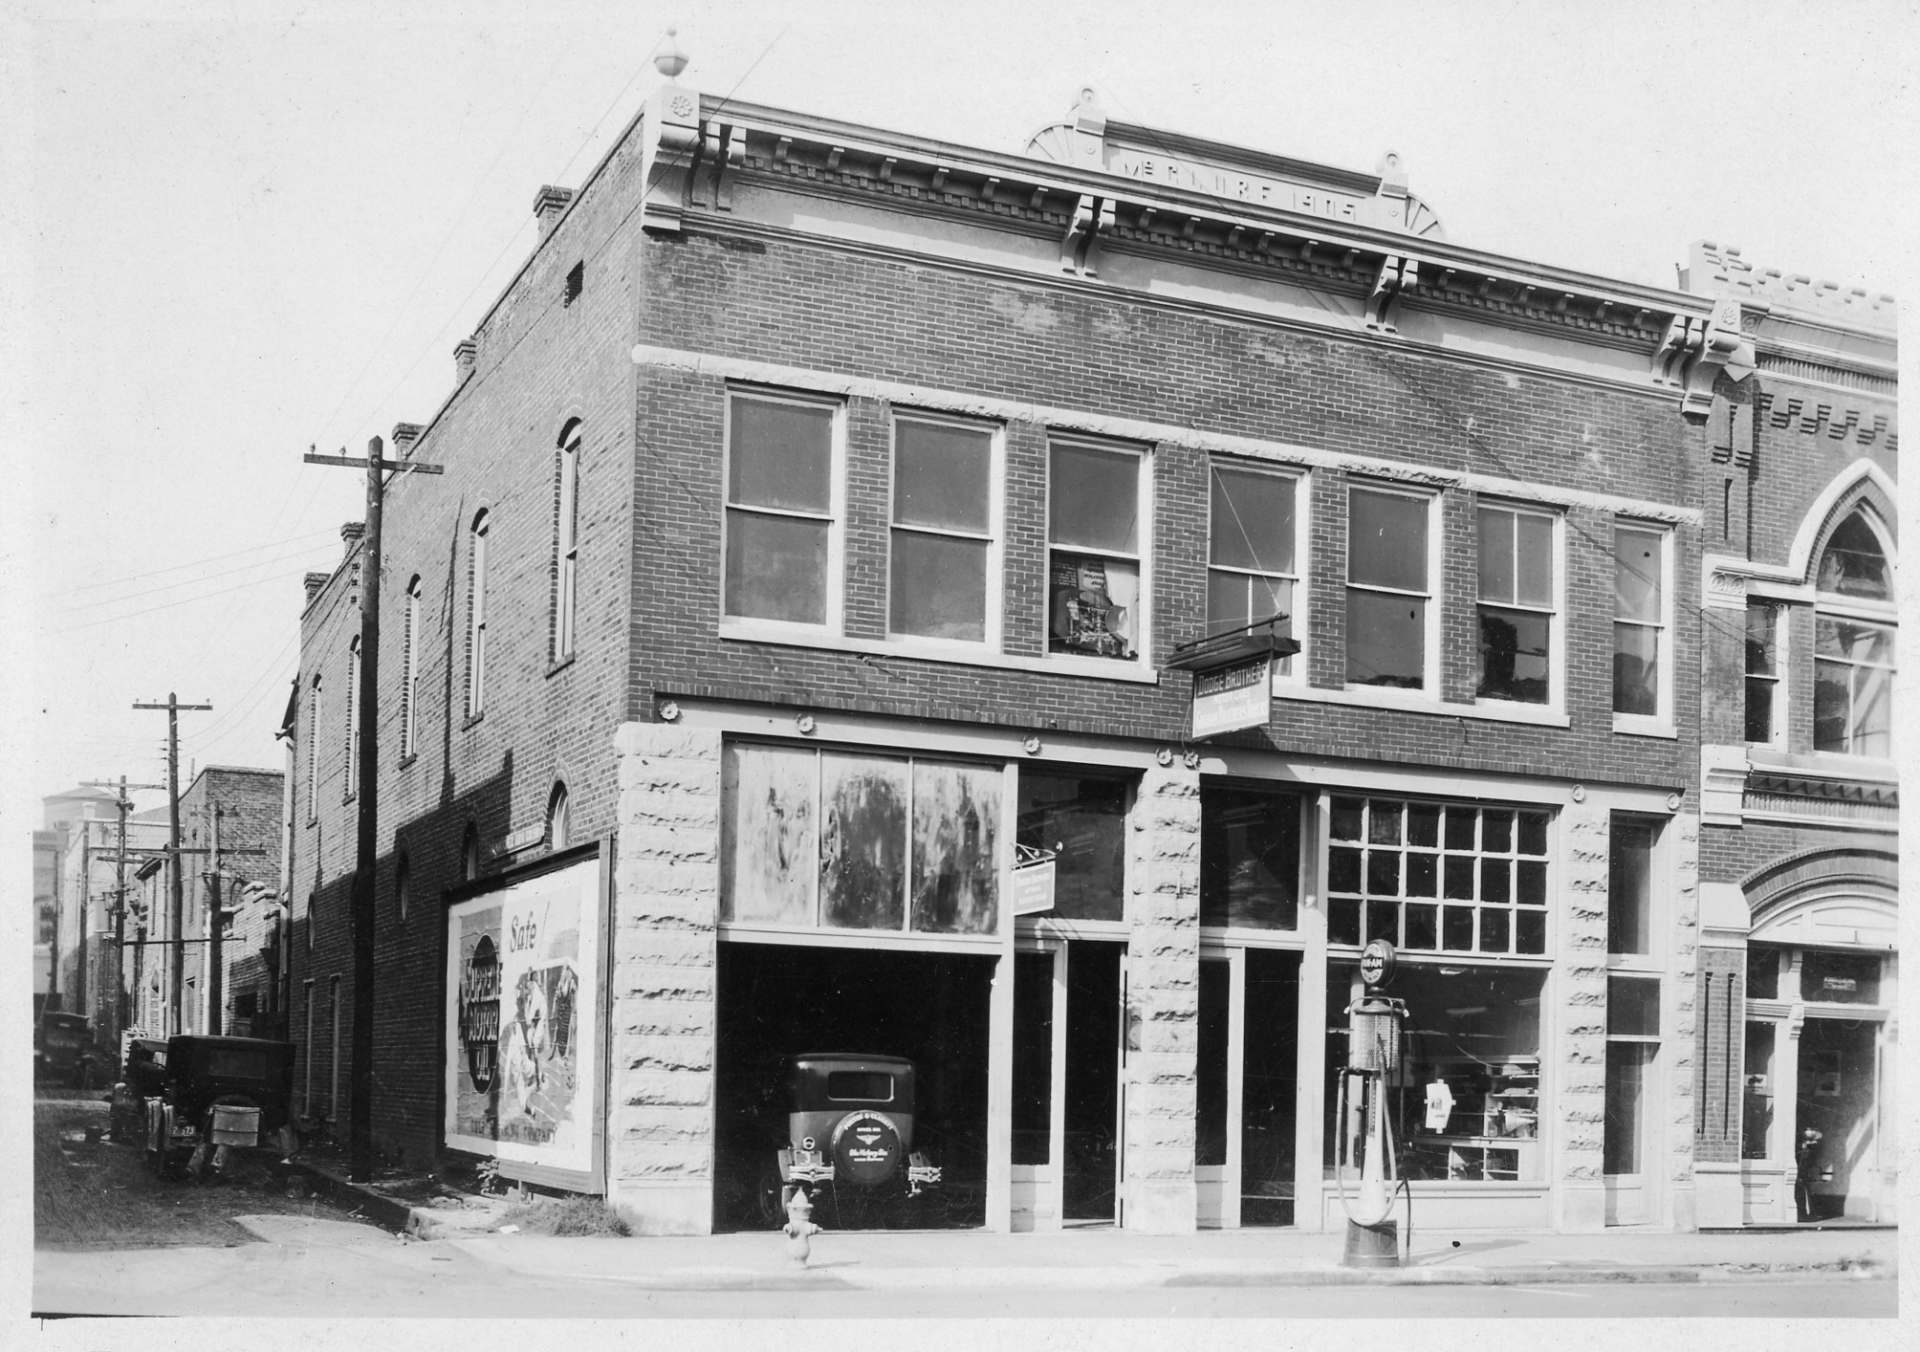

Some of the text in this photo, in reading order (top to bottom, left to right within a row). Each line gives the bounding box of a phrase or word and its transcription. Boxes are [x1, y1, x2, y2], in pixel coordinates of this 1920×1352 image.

[1198, 661, 1267, 697] DODGE BROTHERS
[467, 1007, 499, 1042] MOTOR
